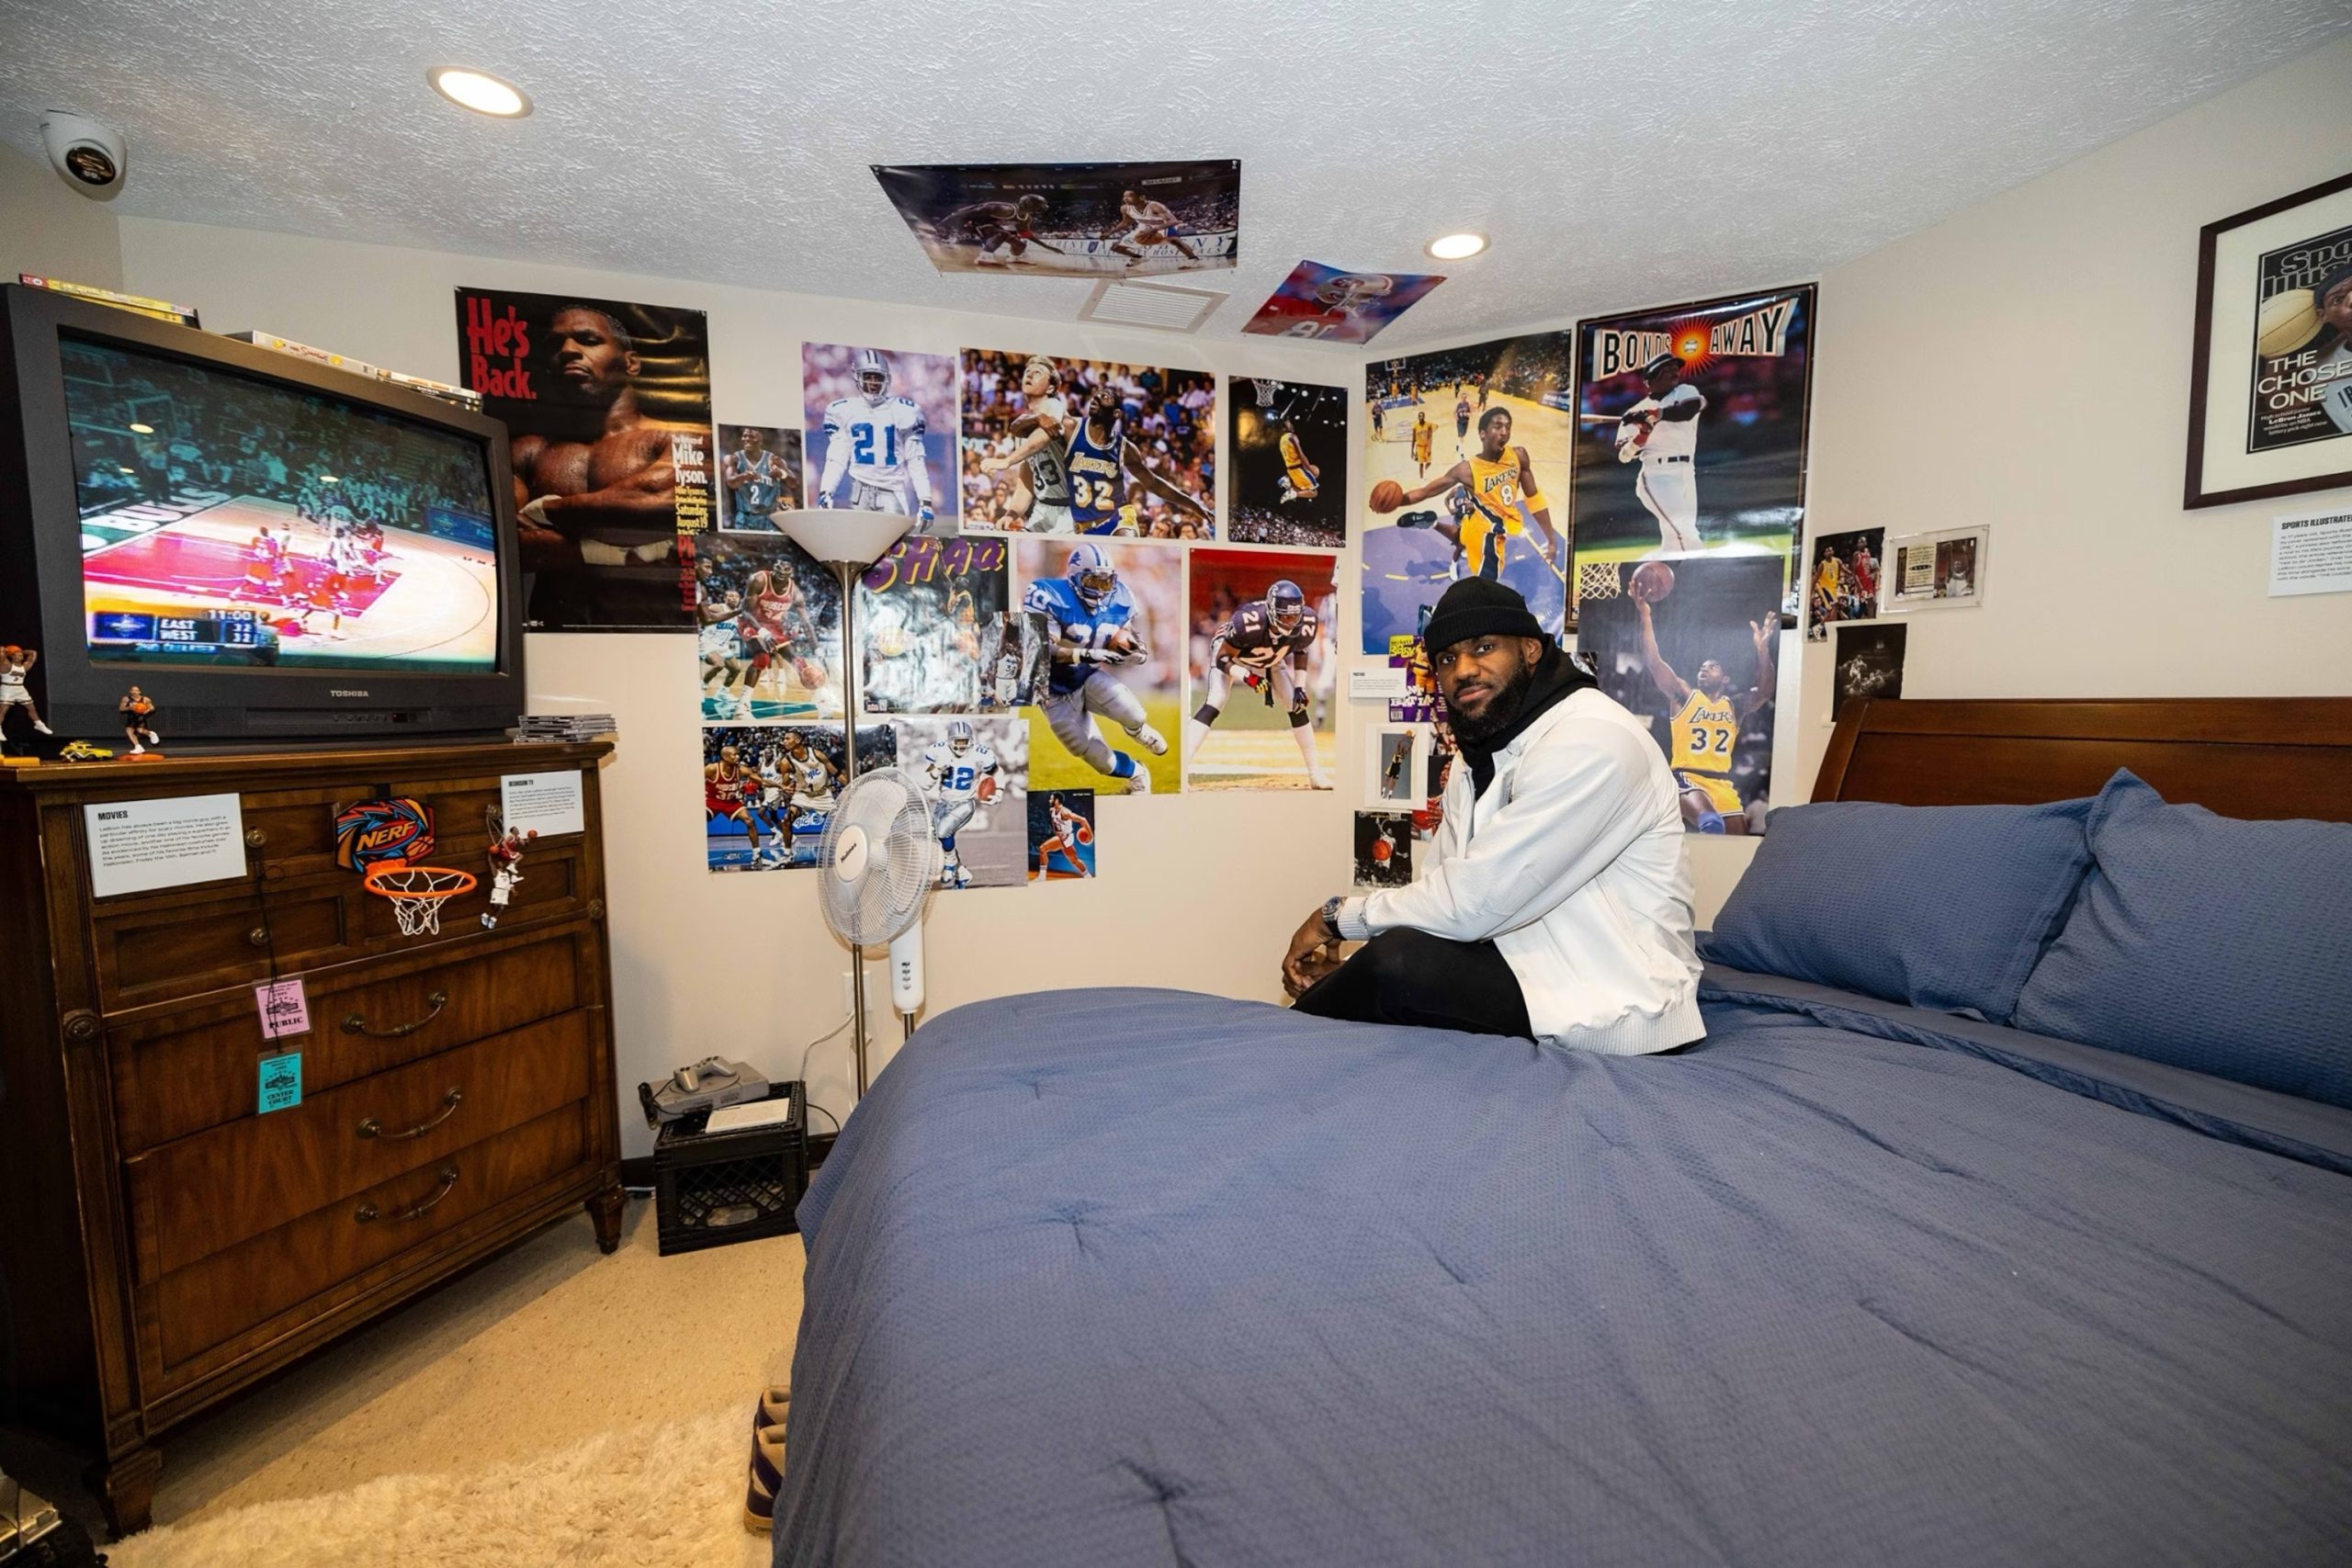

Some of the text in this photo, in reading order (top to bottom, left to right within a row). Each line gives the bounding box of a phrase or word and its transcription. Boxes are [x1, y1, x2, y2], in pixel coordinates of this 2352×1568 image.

[467, 297, 530, 358] He's
[1600, 299, 1791, 379] BONDS AWAY
[2268, 350, 2318, 373] THE
[470, 355, 537, 400] Back.
[2269, 384, 2328, 410] ONE
[672, 441, 705, 466] Mike
[851, 423, 898, 466] 21
[674, 464, 708, 487] Tyson.
[1034, 459, 1061, 491] 33
[1484, 467, 1519, 493] LAKERS
[751, 485, 760, 504] 2
[1073, 475, 1115, 511] 32
[1500, 484, 1513, 507] 8
[2281, 520, 2309, 529] SPORTS
[861, 537, 1007, 594] SHAQ
[160, 619, 252, 632] EAST 32
[208, 610, 252, 621] 11:00
[1242, 611, 1261, 633] 21
[1301, 615, 1316, 637] 21
[160, 630, 252, 643] WEST 32
[1238, 645, 1291, 669] 21
[1688, 706, 1734, 724] LAKERS
[1690, 728, 1729, 752] 32
[97, 810, 129, 820] MOVIES
[356, 820, 417, 852] NERF
[269, 1017, 303, 1029] PUBLIC
